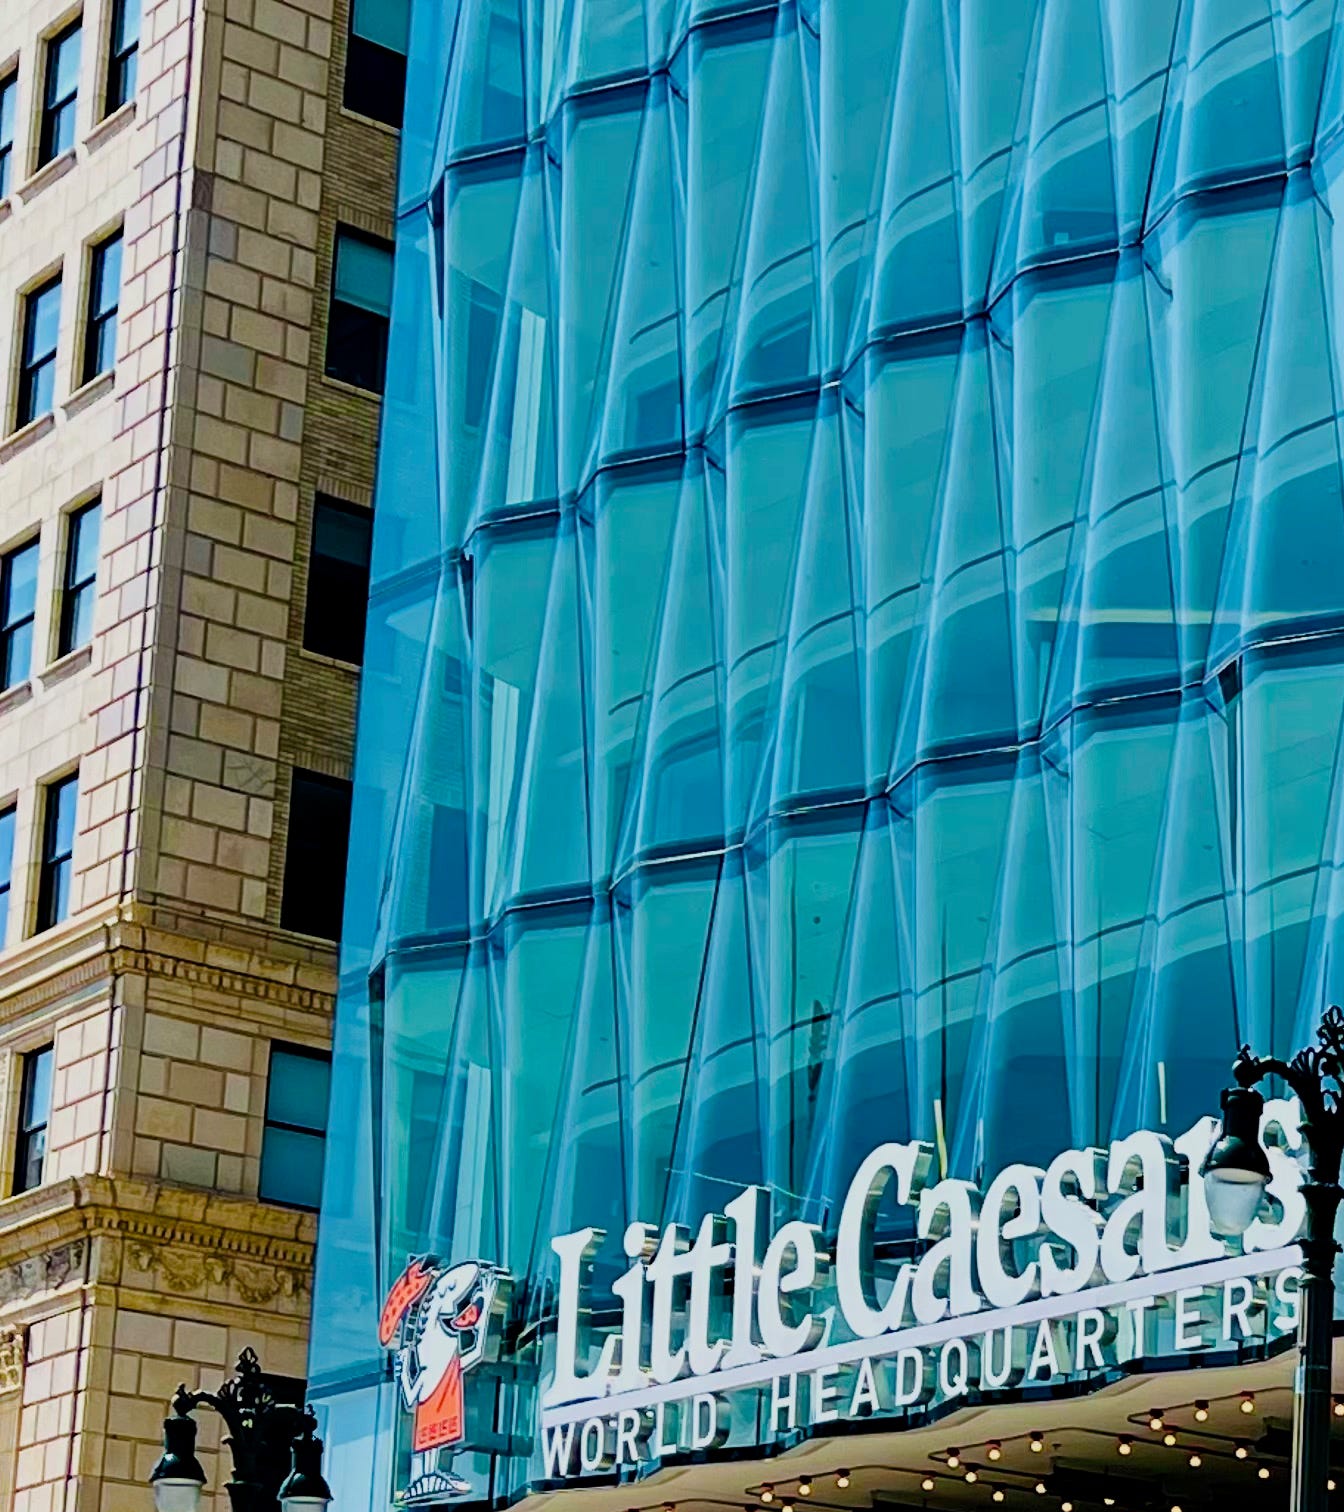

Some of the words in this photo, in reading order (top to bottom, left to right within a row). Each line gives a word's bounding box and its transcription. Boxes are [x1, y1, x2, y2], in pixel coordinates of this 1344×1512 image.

[542, 1393, 717, 1479] WORLD
[770, 1266, 1303, 1432] HEADQUARTERS
[543, 1185, 832, 1409] Little
[836, 1097, 1306, 1338] Caesars
